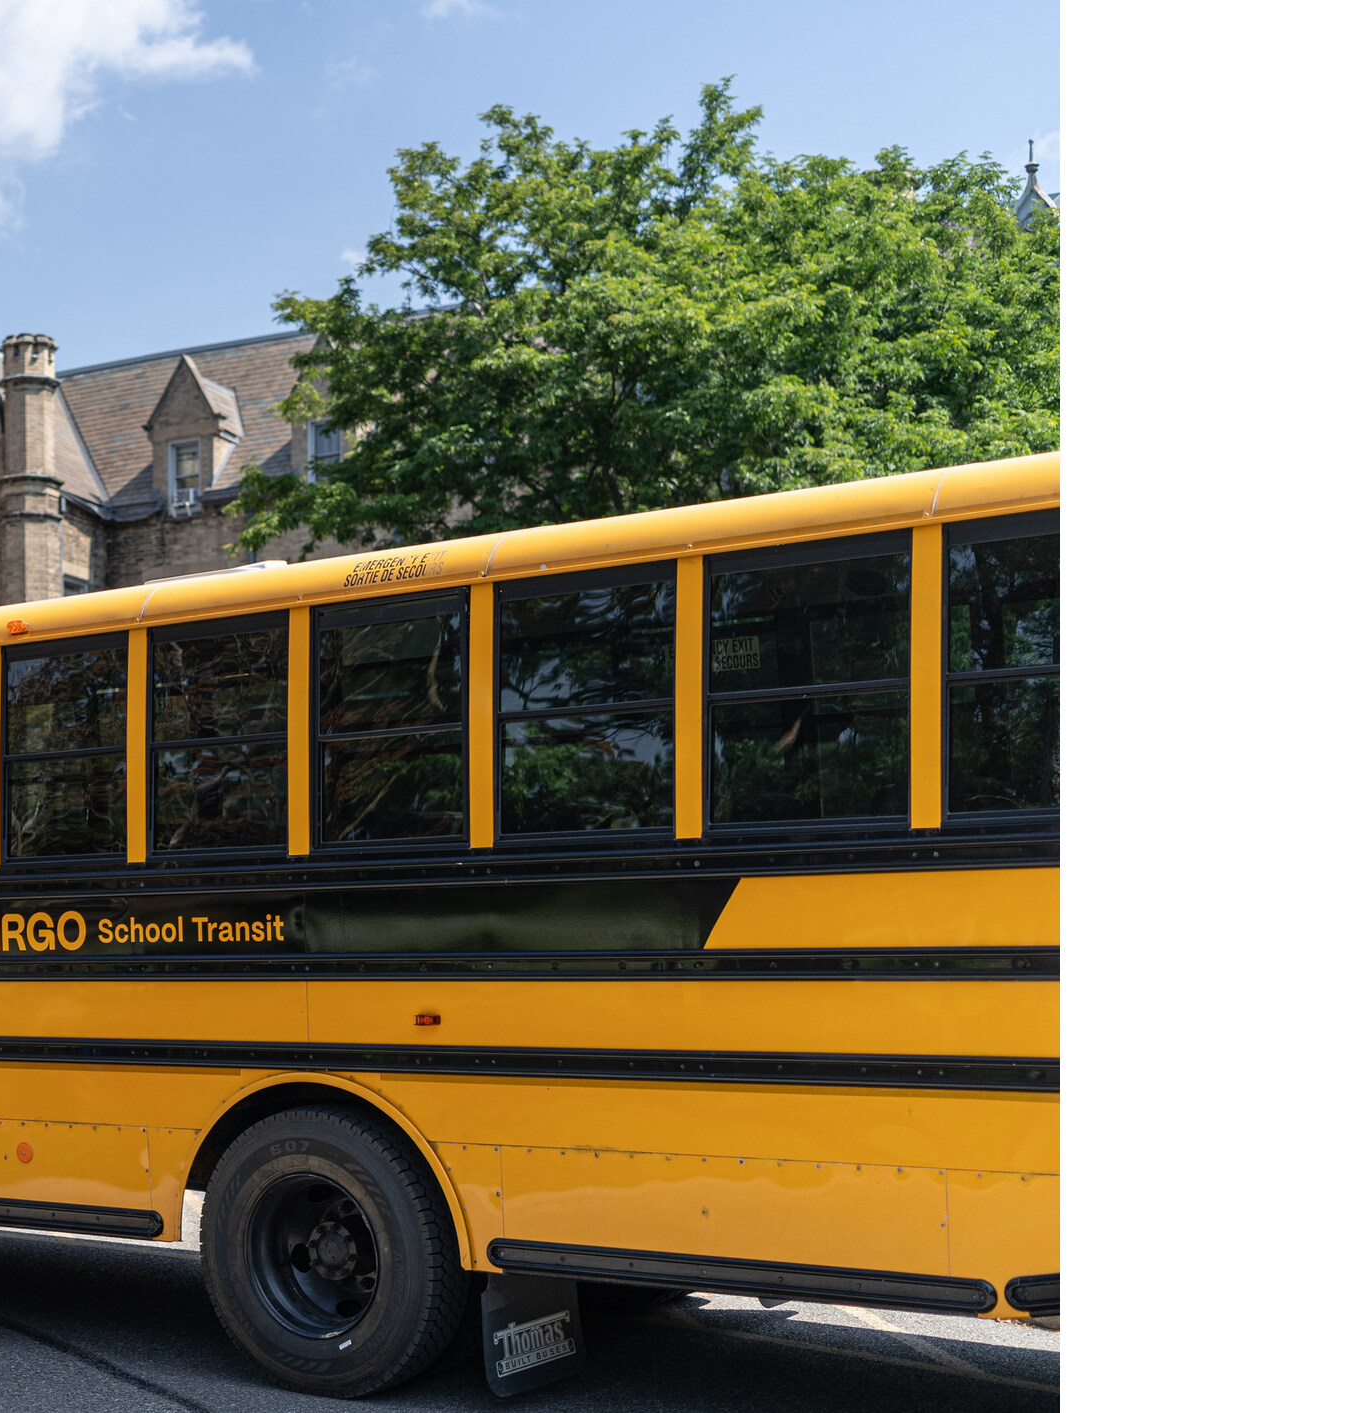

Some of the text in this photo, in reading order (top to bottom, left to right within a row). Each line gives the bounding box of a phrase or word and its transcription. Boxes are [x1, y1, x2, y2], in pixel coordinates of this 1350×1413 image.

[343, 561, 444, 588] SORTIE DE SECOURS
[732, 637, 754, 653] EXIT
[715, 653, 758, 671] SECOURS
[98, 916, 183, 943] School
[191, 914, 285, 942] Transit
[494, 1311, 570, 1360] Thomas
[505, 1344, 567, 1370] BUILT BUSES
